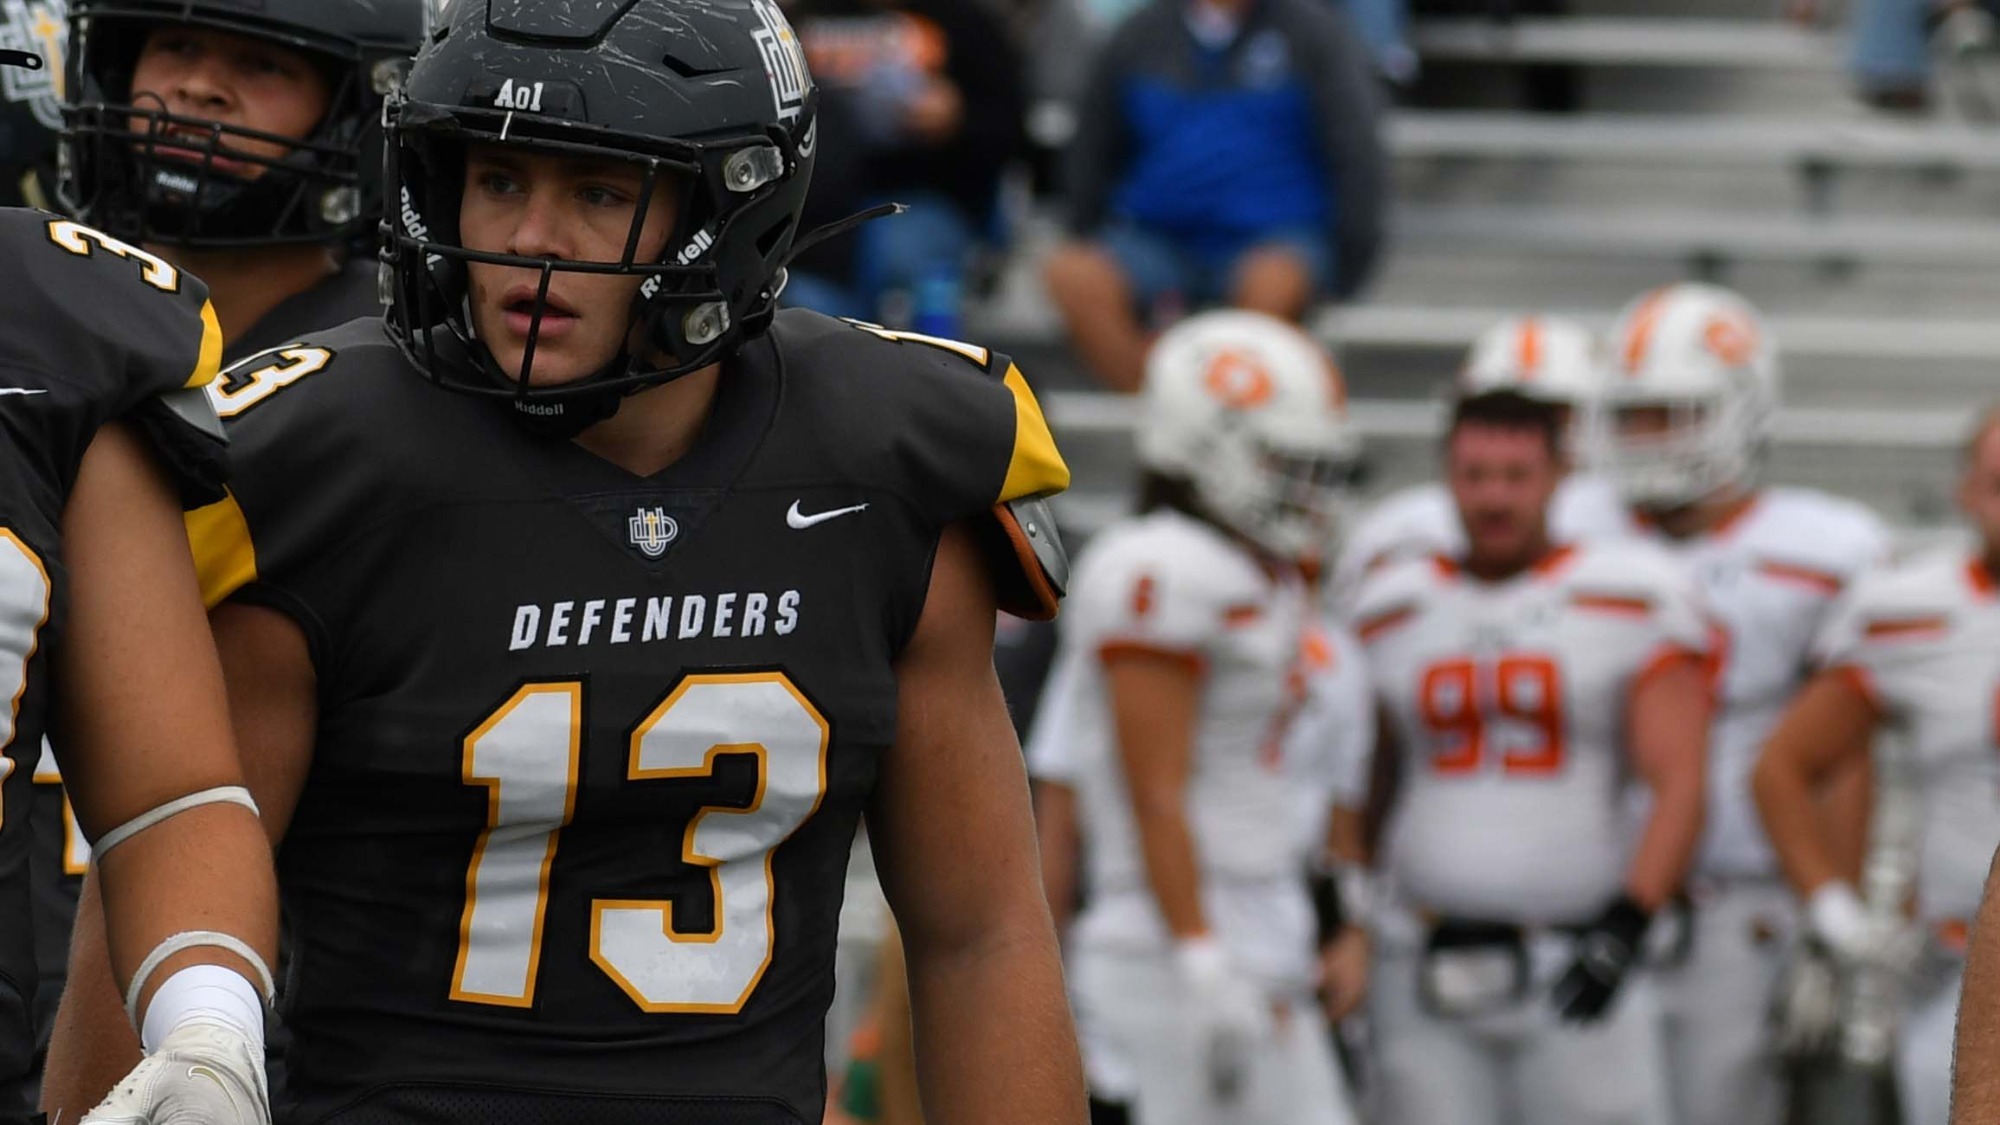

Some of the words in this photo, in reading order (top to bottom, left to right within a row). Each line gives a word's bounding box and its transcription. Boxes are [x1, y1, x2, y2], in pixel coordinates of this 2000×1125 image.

[156, 171, 199, 194] Riddel
[204, 343, 332, 417] 3
[508, 590, 801, 651] DEFENDERS
[1418, 654, 1567, 775] 99
[449, 671, 830, 1014] 13
